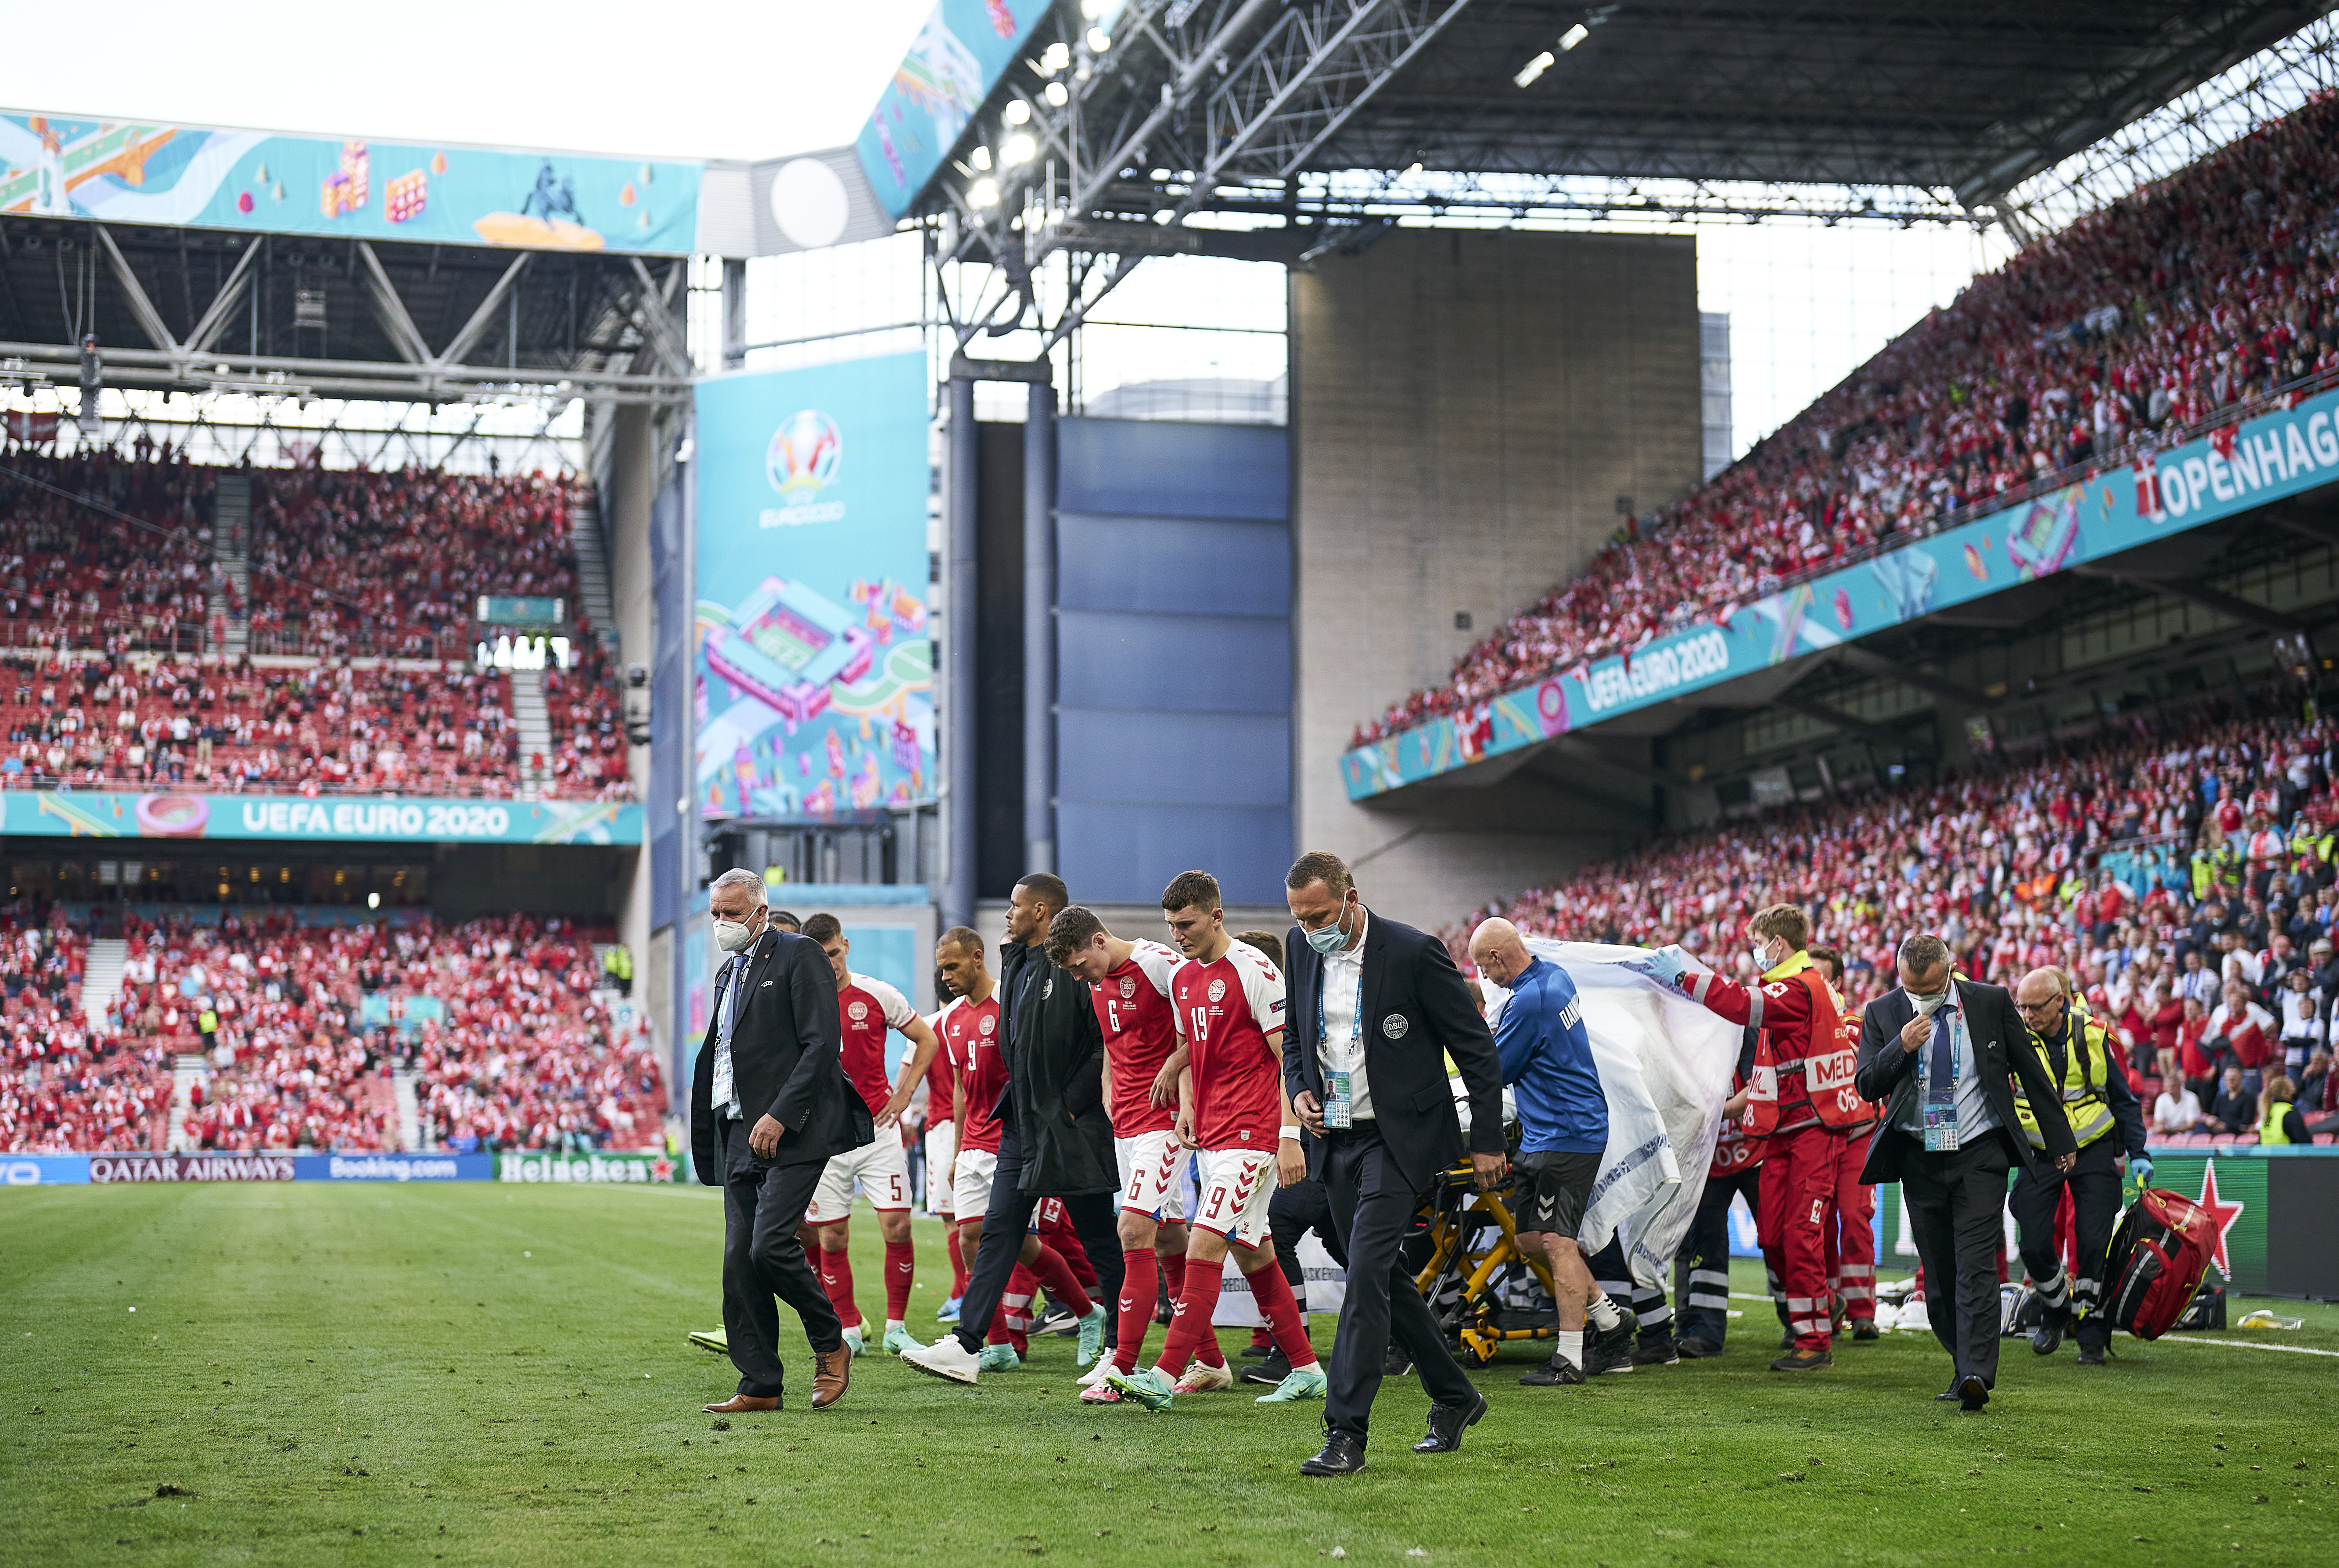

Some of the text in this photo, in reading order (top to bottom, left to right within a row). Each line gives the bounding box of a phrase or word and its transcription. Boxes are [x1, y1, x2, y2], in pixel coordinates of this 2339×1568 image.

[2148, 402, 2339, 524] OPENHAG
[1583, 630, 1728, 712] UEFA EURO 2020
[242, 801, 510, 836] UEFA EURO 2020
[1108, 1000, 1121, 1032] 6
[1191, 1006, 1207, 1041] 19
[1388, 1022, 1403, 1030] DBU
[967, 1040, 977, 1071] 9
[90, 1157, 295, 1183] QATAR AIRWAYS
[329, 1156, 457, 1182] Booking.com
[499, 1154, 648, 1183] Heineken
[1715, 1142, 1749, 1167] 06
[891, 1174, 901, 1201] 5
[1128, 1169, 1146, 1200] 6
[1199, 1186, 1226, 1219] 19
